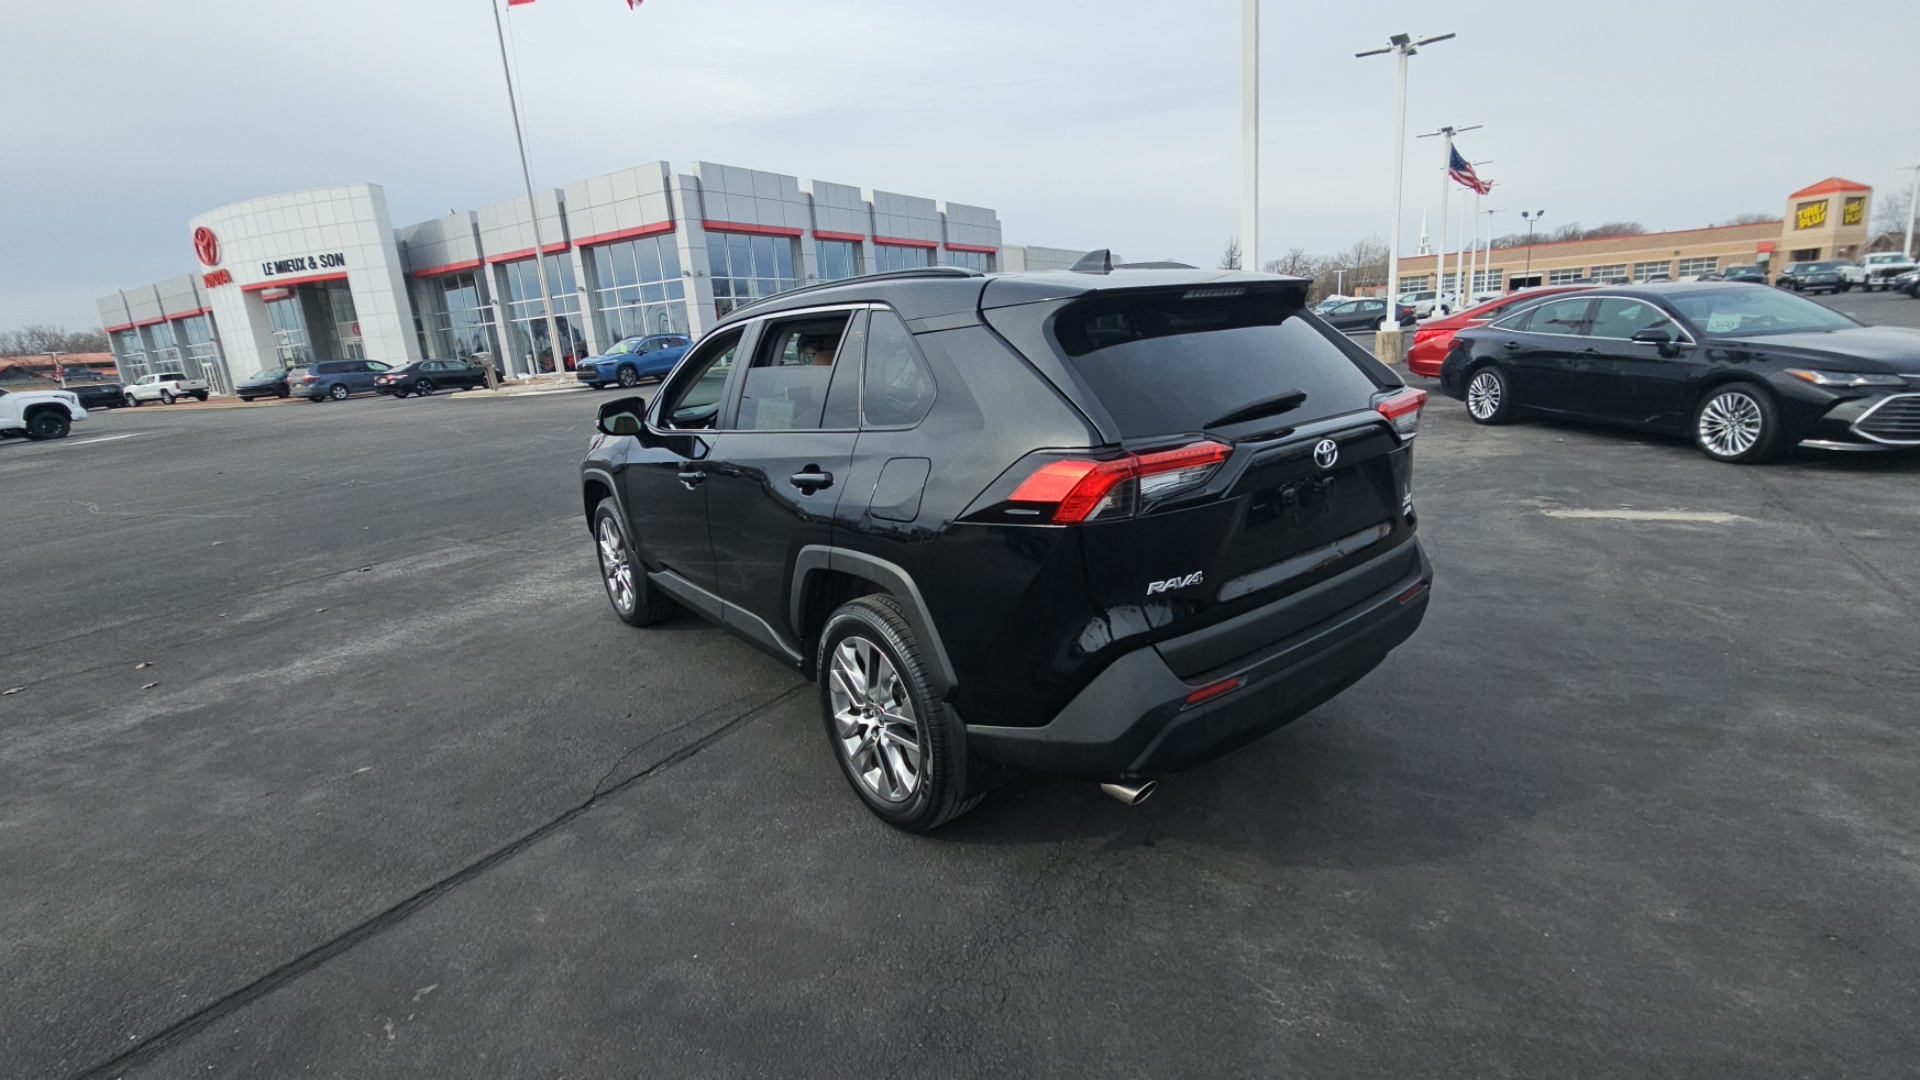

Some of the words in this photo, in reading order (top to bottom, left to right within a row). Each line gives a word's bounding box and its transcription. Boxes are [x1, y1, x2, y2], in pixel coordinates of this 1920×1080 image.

[1797, 202, 1827, 219] TIRES
[1799, 211, 1826, 230] PLUS
[262, 262, 274, 276] LE
[274, 257, 307, 274] MIEUX
[308, 256, 318, 269] &
[319, 253, 345, 268] SON
[1147, 569, 1203, 596] RAV4
